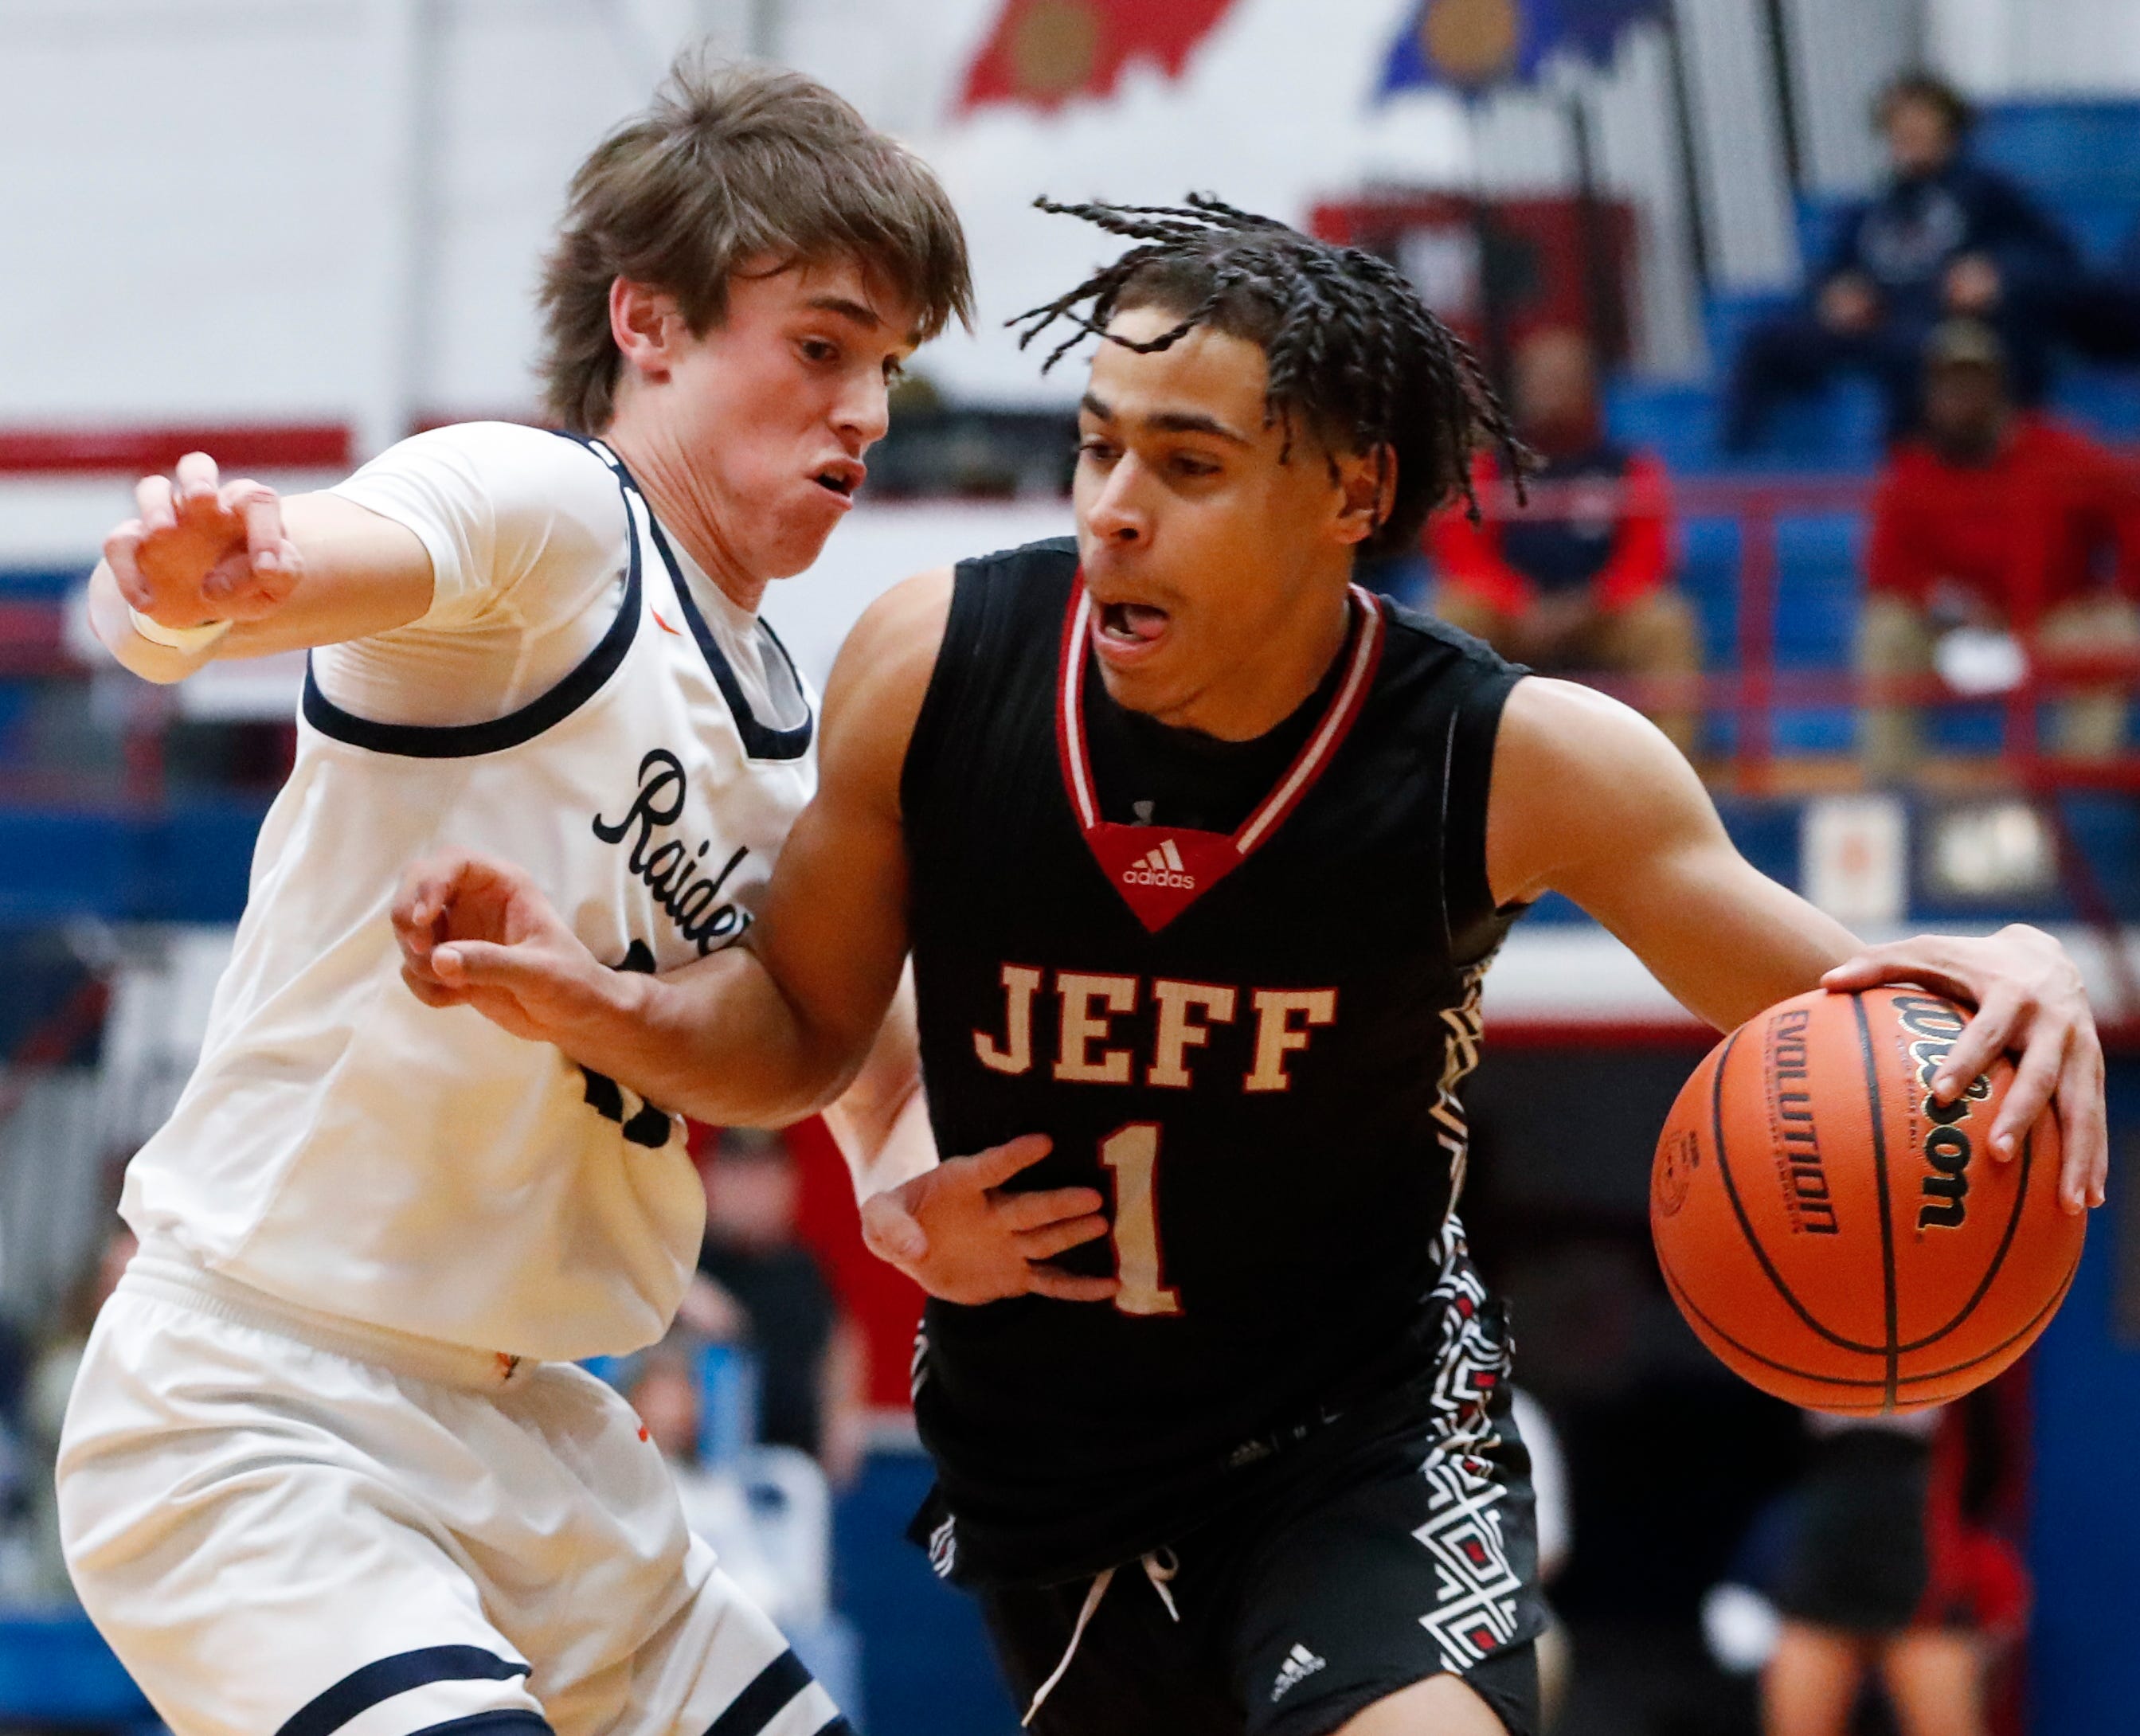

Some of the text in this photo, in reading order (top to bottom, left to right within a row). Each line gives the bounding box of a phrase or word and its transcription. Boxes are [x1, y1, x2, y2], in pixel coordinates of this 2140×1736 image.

[1122, 866, 1195, 890] adidas
[972, 960, 1340, 1093] JEFF
[1775, 1009, 1839, 1234] EVOLUTION
[1098, 1120, 1186, 1318] 1
